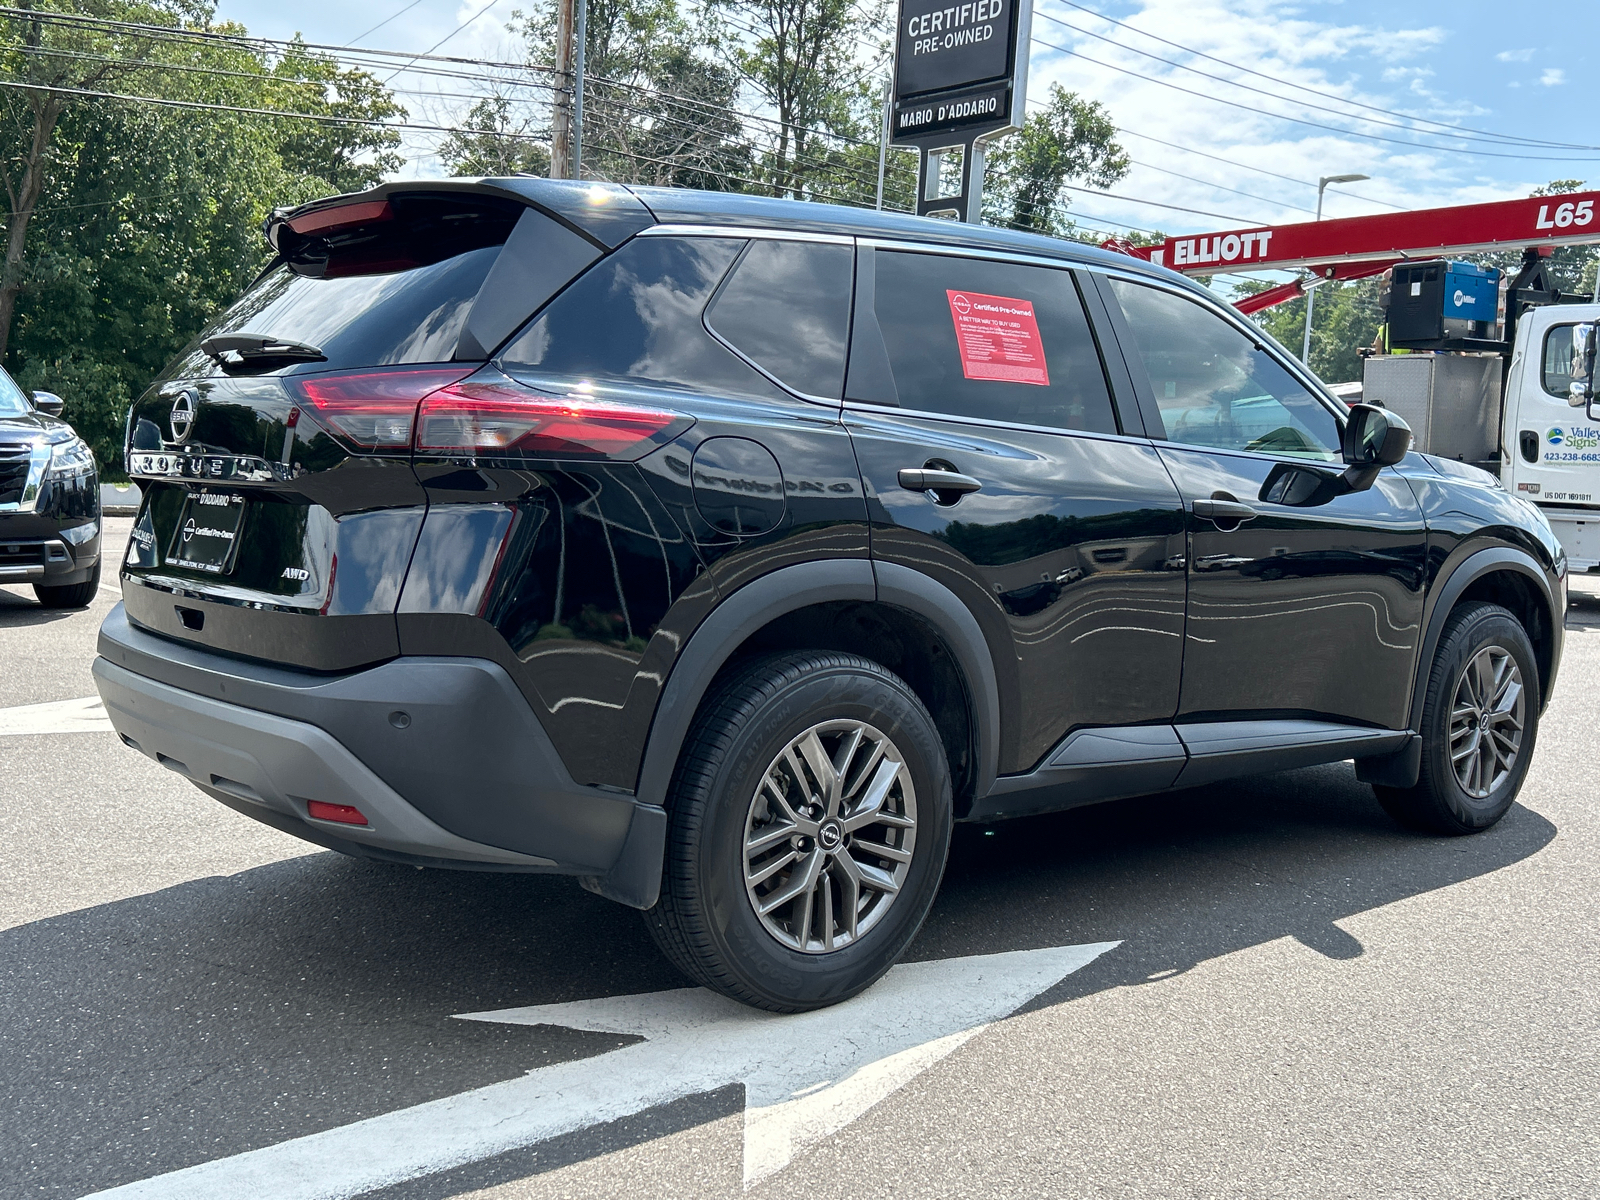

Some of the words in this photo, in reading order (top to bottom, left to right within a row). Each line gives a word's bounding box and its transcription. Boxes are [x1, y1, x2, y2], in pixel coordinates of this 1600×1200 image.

[908, 0, 1002, 37] CERTIFIED
[914, 25, 993, 55] PRE-OWNED
[900, 109, 932, 128] MARIO
[938, 98, 996, 121] D'ADDARIO
[1536, 201, 1594, 229] L65
[1174, 231, 1272, 265] ELLIOTT
[974, 303, 999, 312] Certified
[1000, 307, 1032, 317] Pre-Owned
[1571, 427, 1600, 440] Valley
[1565, 436, 1597, 450] Signs
[1544, 452, 1600, 462] 423-238-6683
[142, 456, 223, 476] ROGUE
[1545, 491, 1553, 499] US
[1554, 492, 1567, 500] DOT
[280, 567, 310, 581] AWD
